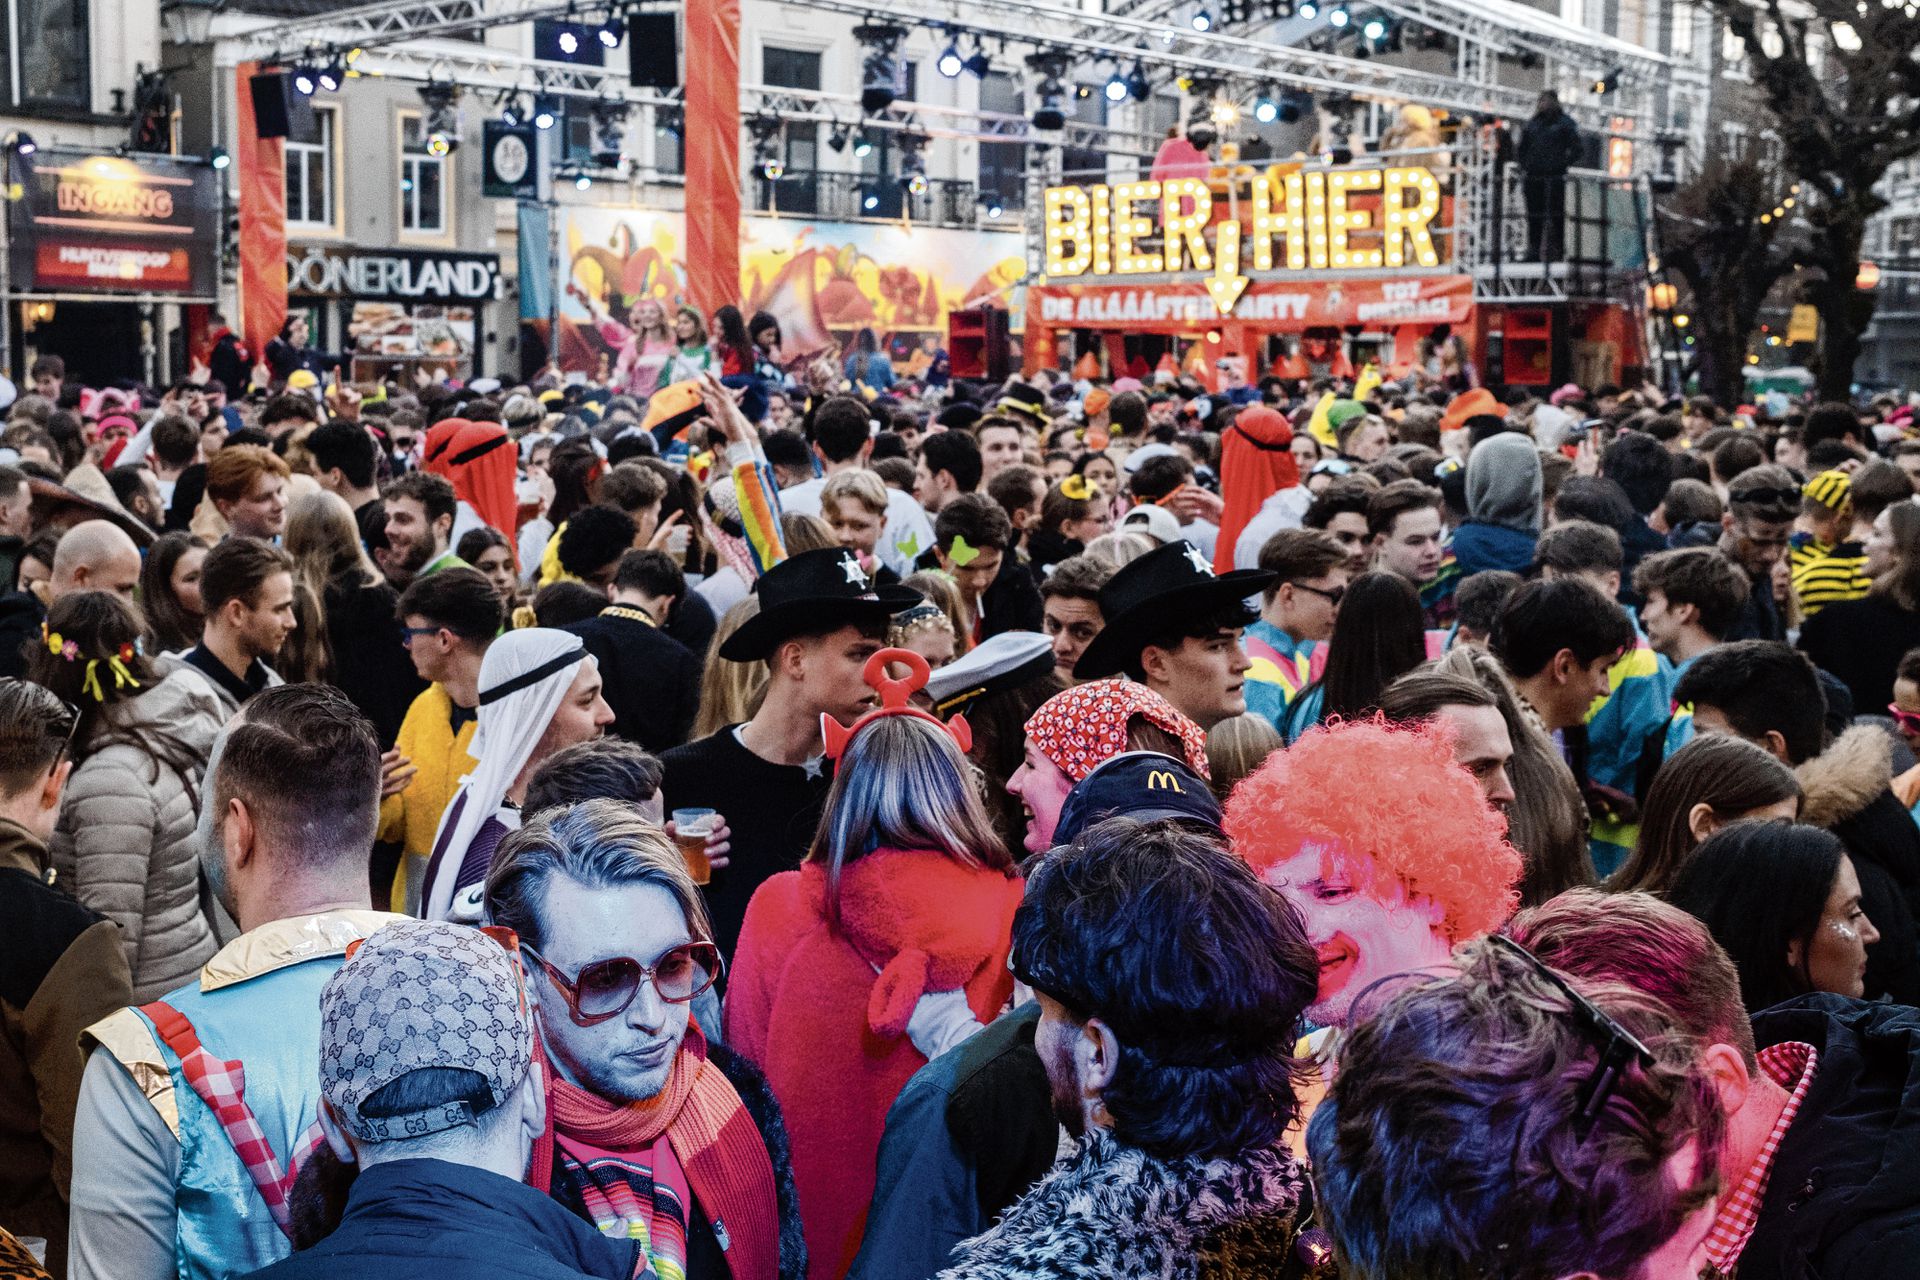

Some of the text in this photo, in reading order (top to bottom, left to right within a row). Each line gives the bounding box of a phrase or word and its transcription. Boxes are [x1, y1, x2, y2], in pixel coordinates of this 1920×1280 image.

[57, 182, 174, 219] INGANG
[1044, 166, 1440, 277] BIER HIER
[1042, 296, 1074, 321] DE
[1222, 293, 1311, 320] ARTY
